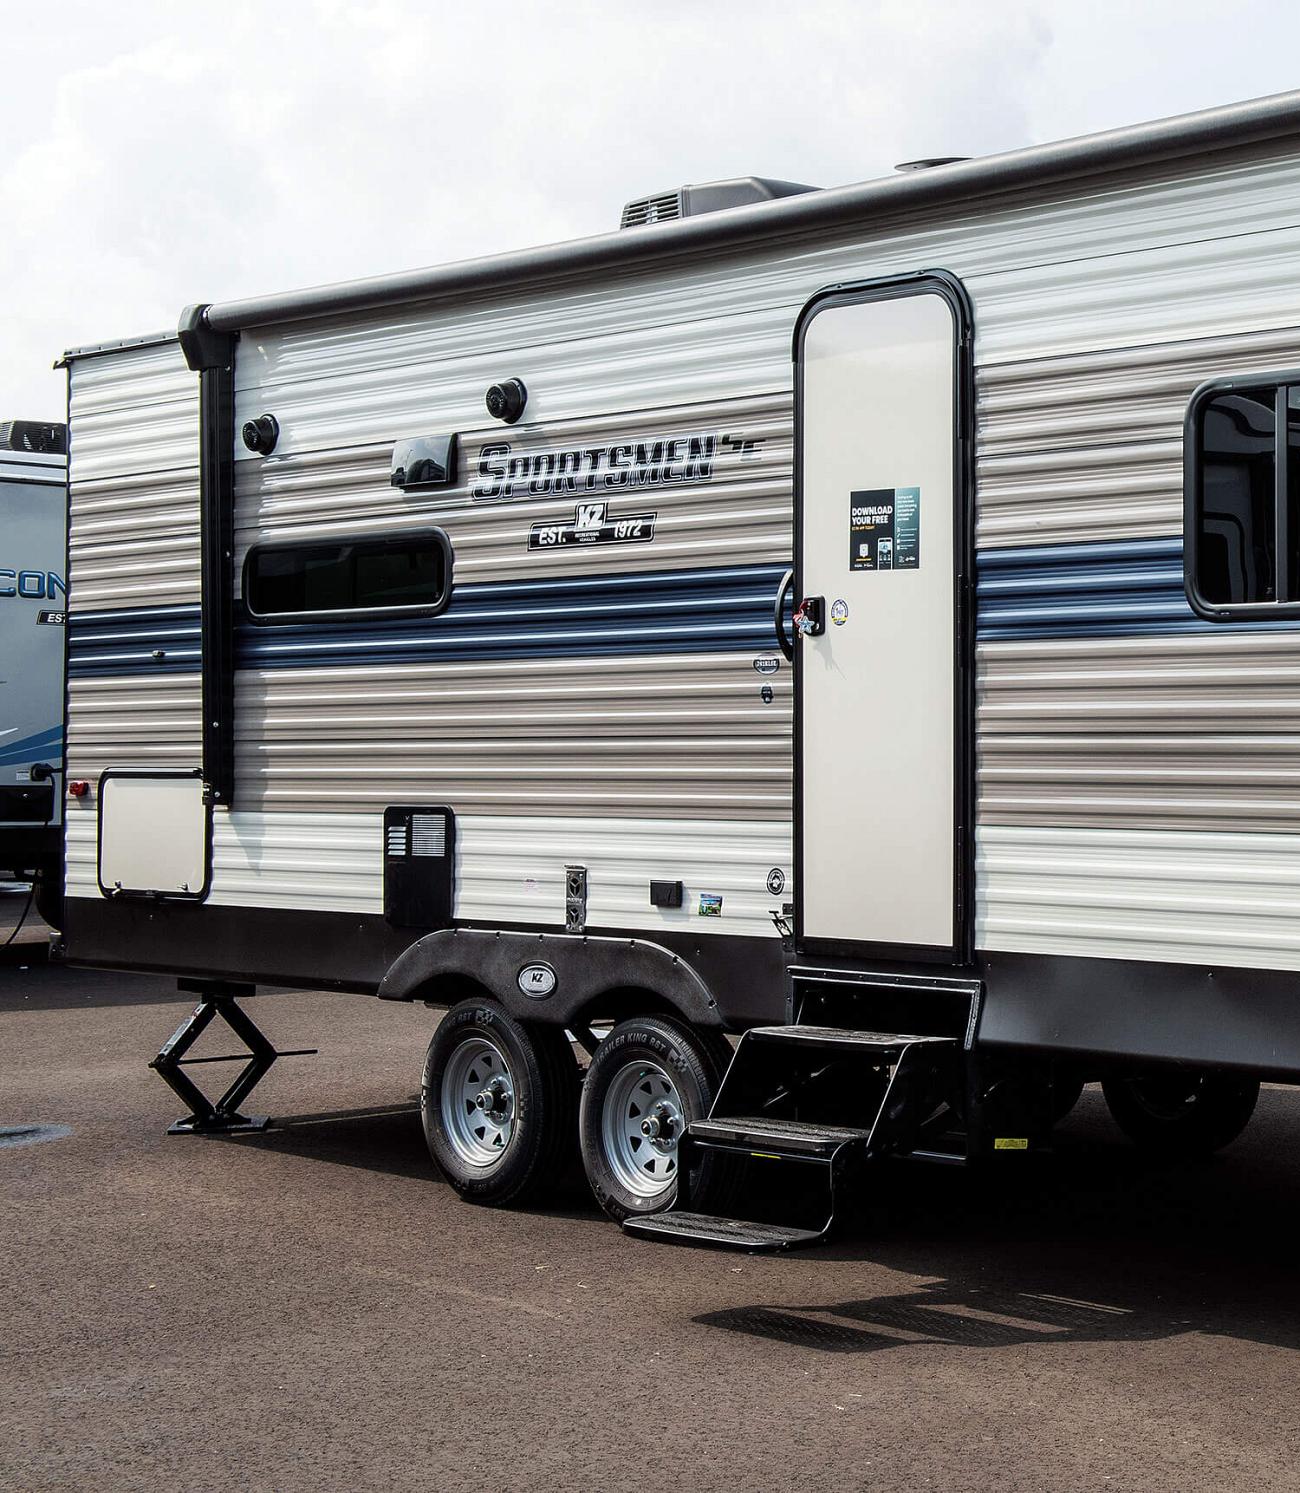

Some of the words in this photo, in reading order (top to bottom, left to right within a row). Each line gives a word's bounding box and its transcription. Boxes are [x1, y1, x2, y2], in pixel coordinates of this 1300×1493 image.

[472, 434, 717, 501] SPORTSMEN
[577, 504, 604, 528] KZ
[852, 506, 893, 516] DOWNLOAD
[852, 517, 871, 525] YOUR
[872, 515, 889, 524] FREE
[539, 527, 566, 545] EST.
[614, 520, 641, 538] 1972
[531, 972, 544, 983] KZ
[627, 1032, 648, 1044] KING
